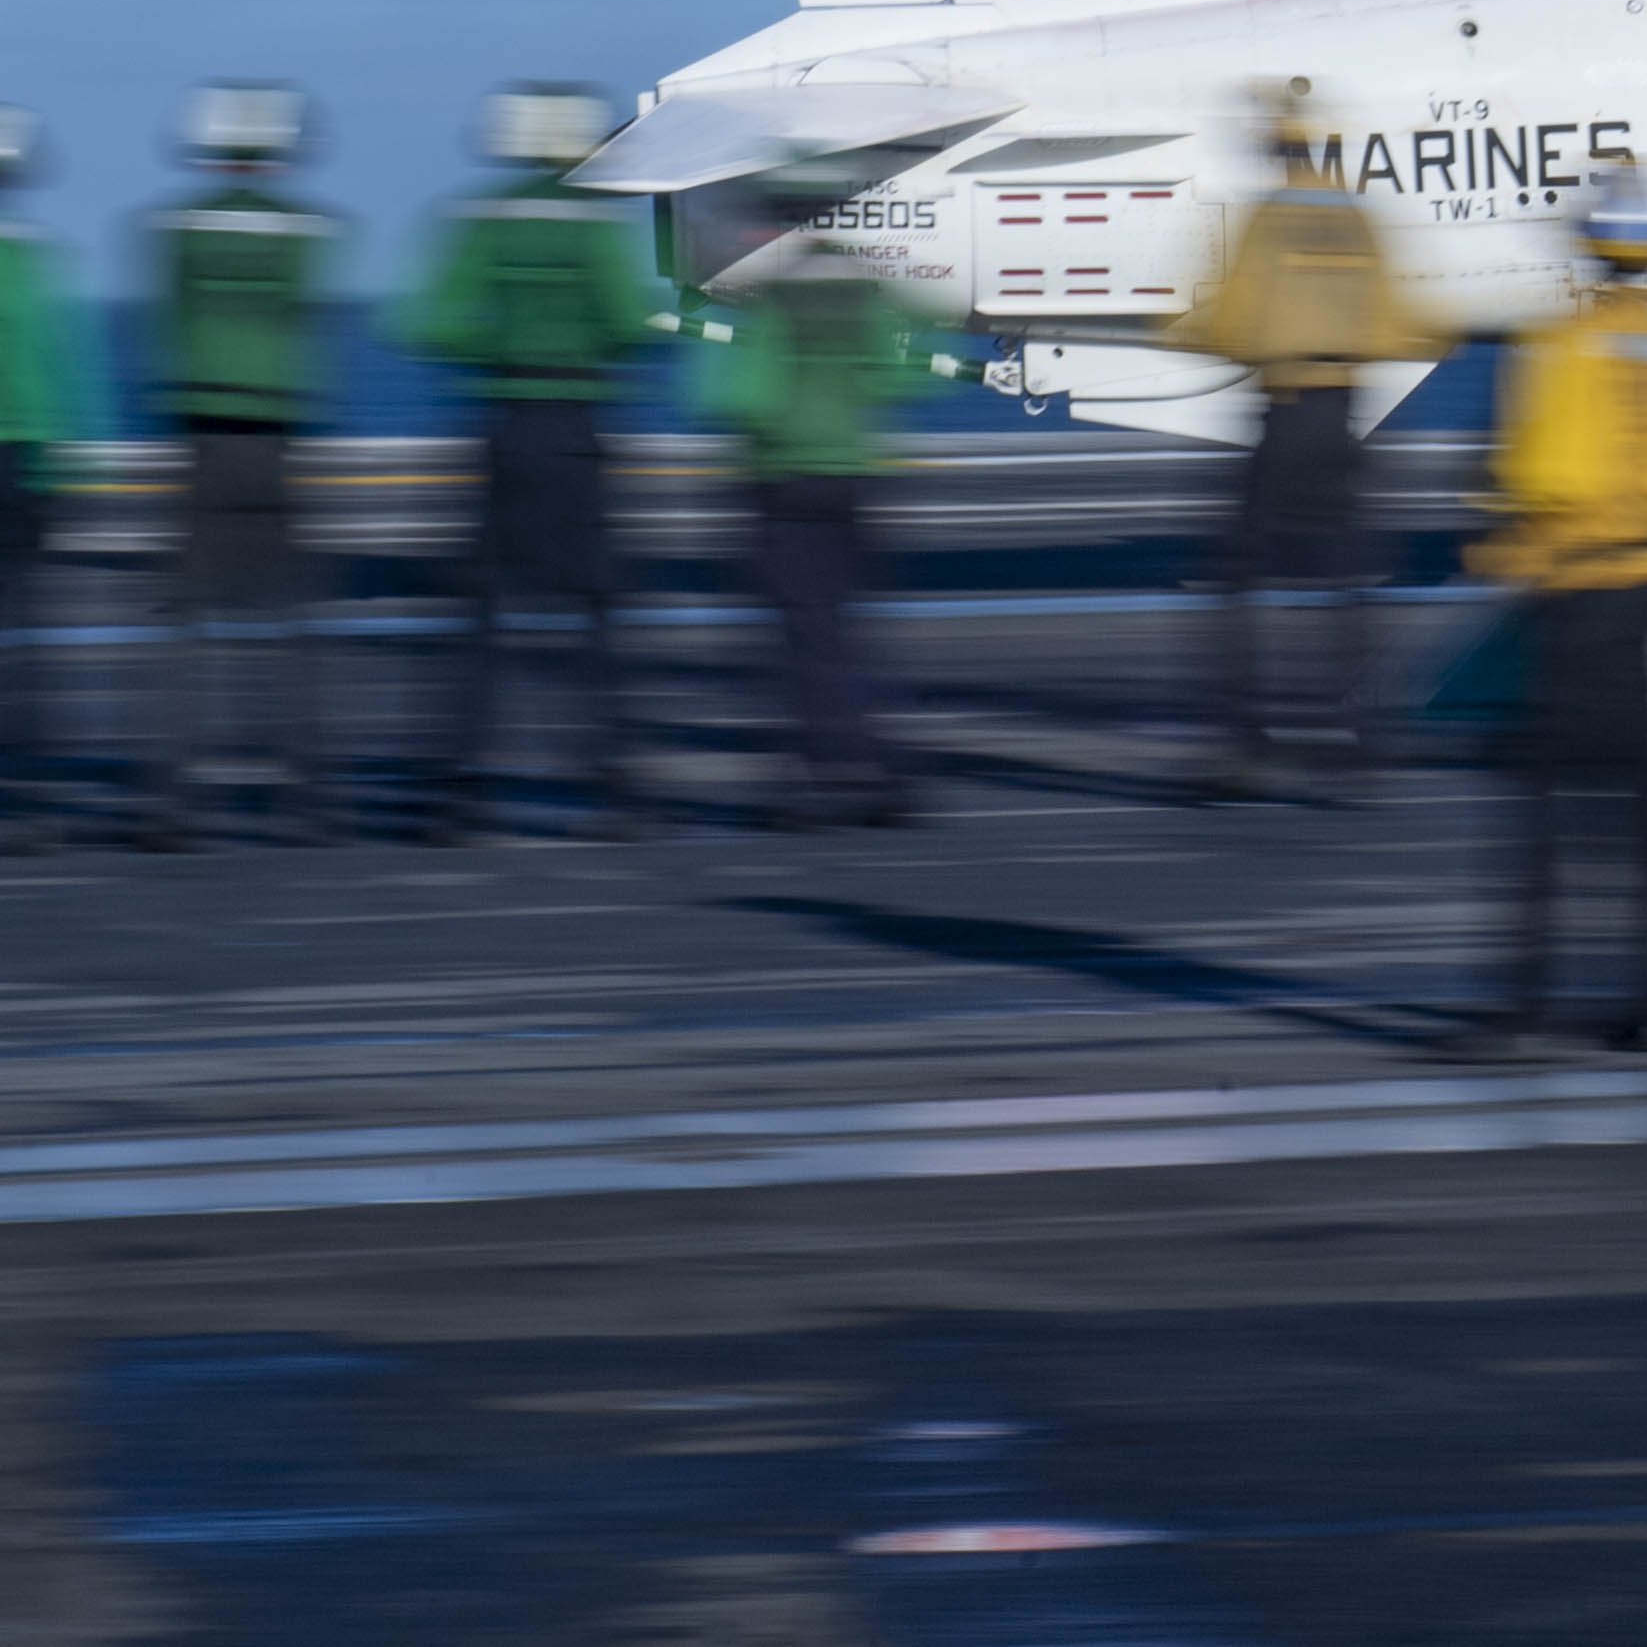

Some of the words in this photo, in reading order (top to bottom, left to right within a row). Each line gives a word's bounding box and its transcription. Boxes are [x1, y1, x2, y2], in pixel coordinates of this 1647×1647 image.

[1429, 99, 1490, 123] VT-9
[1286, 121, 1637, 194] MARINES
[800, 200, 936, 230] 65605
[1431, 197, 1499, 221] TW-1
[905, 264, 955, 279] HOOK
